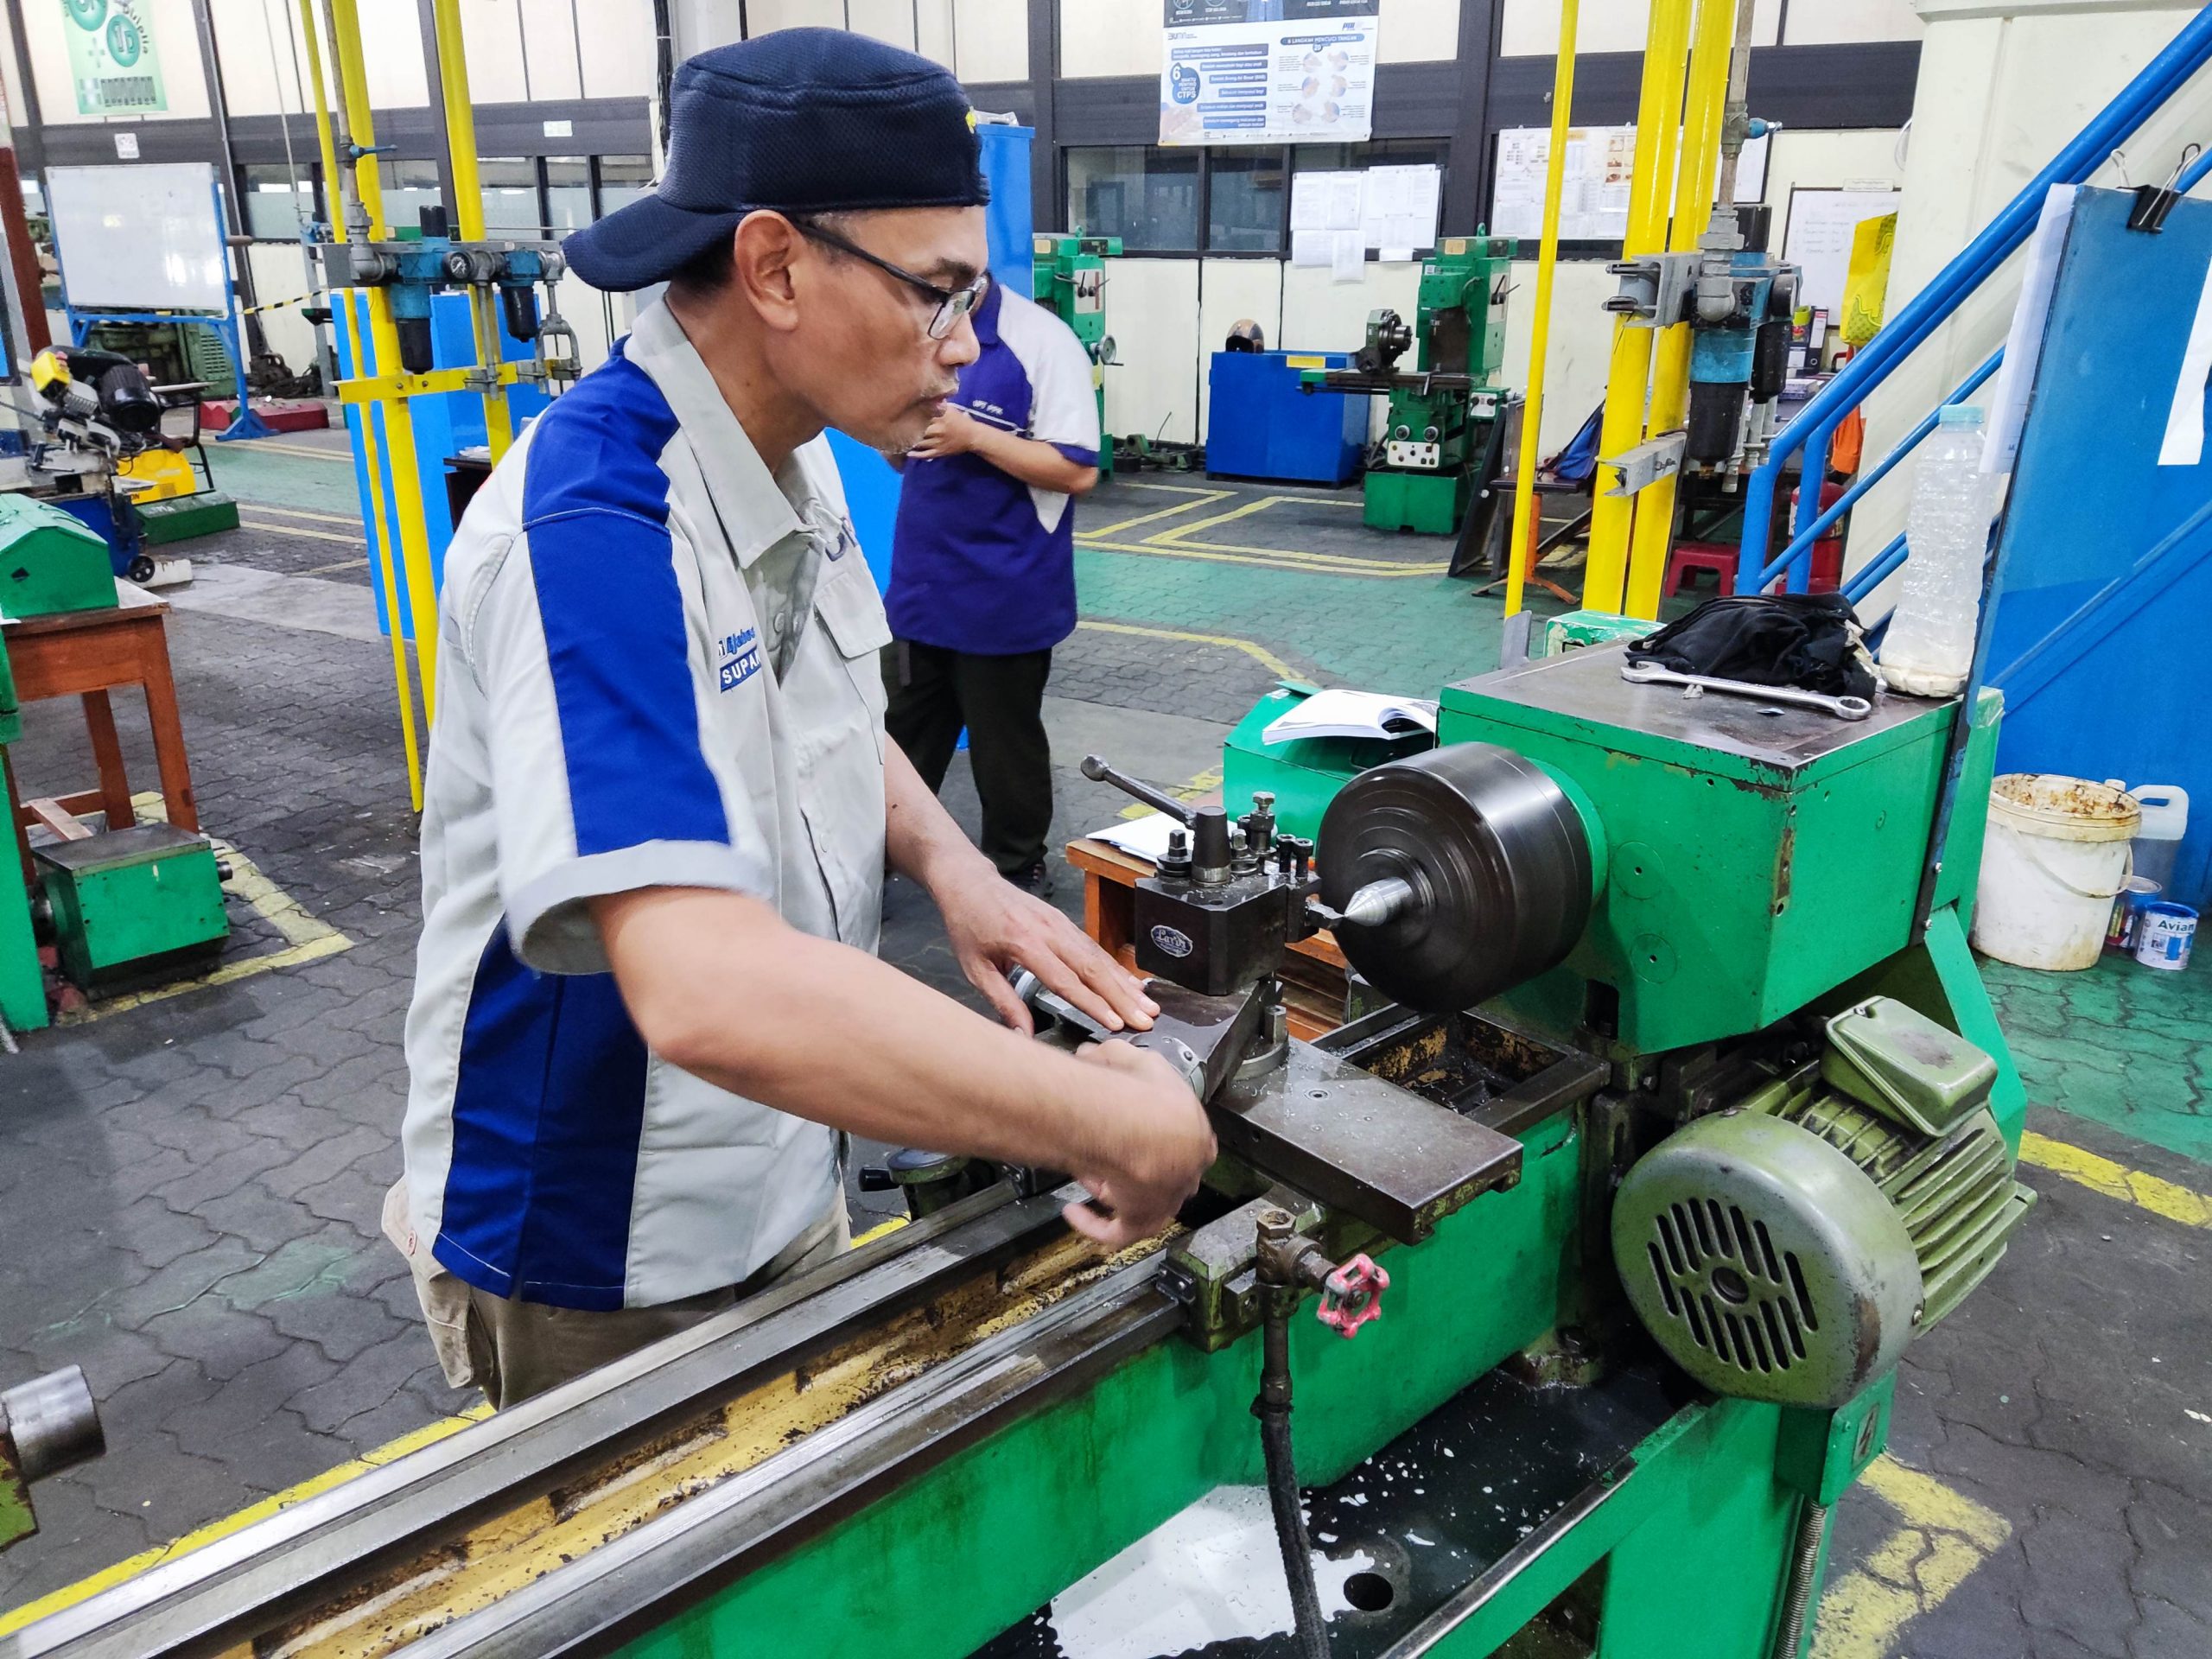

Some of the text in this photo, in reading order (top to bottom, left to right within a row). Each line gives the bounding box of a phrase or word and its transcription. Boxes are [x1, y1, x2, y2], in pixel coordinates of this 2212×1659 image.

[1173, 66, 1181, 81] 6
[1177, 90, 1197, 99] CTPS
[2158, 919, 2196, 932] Avian
